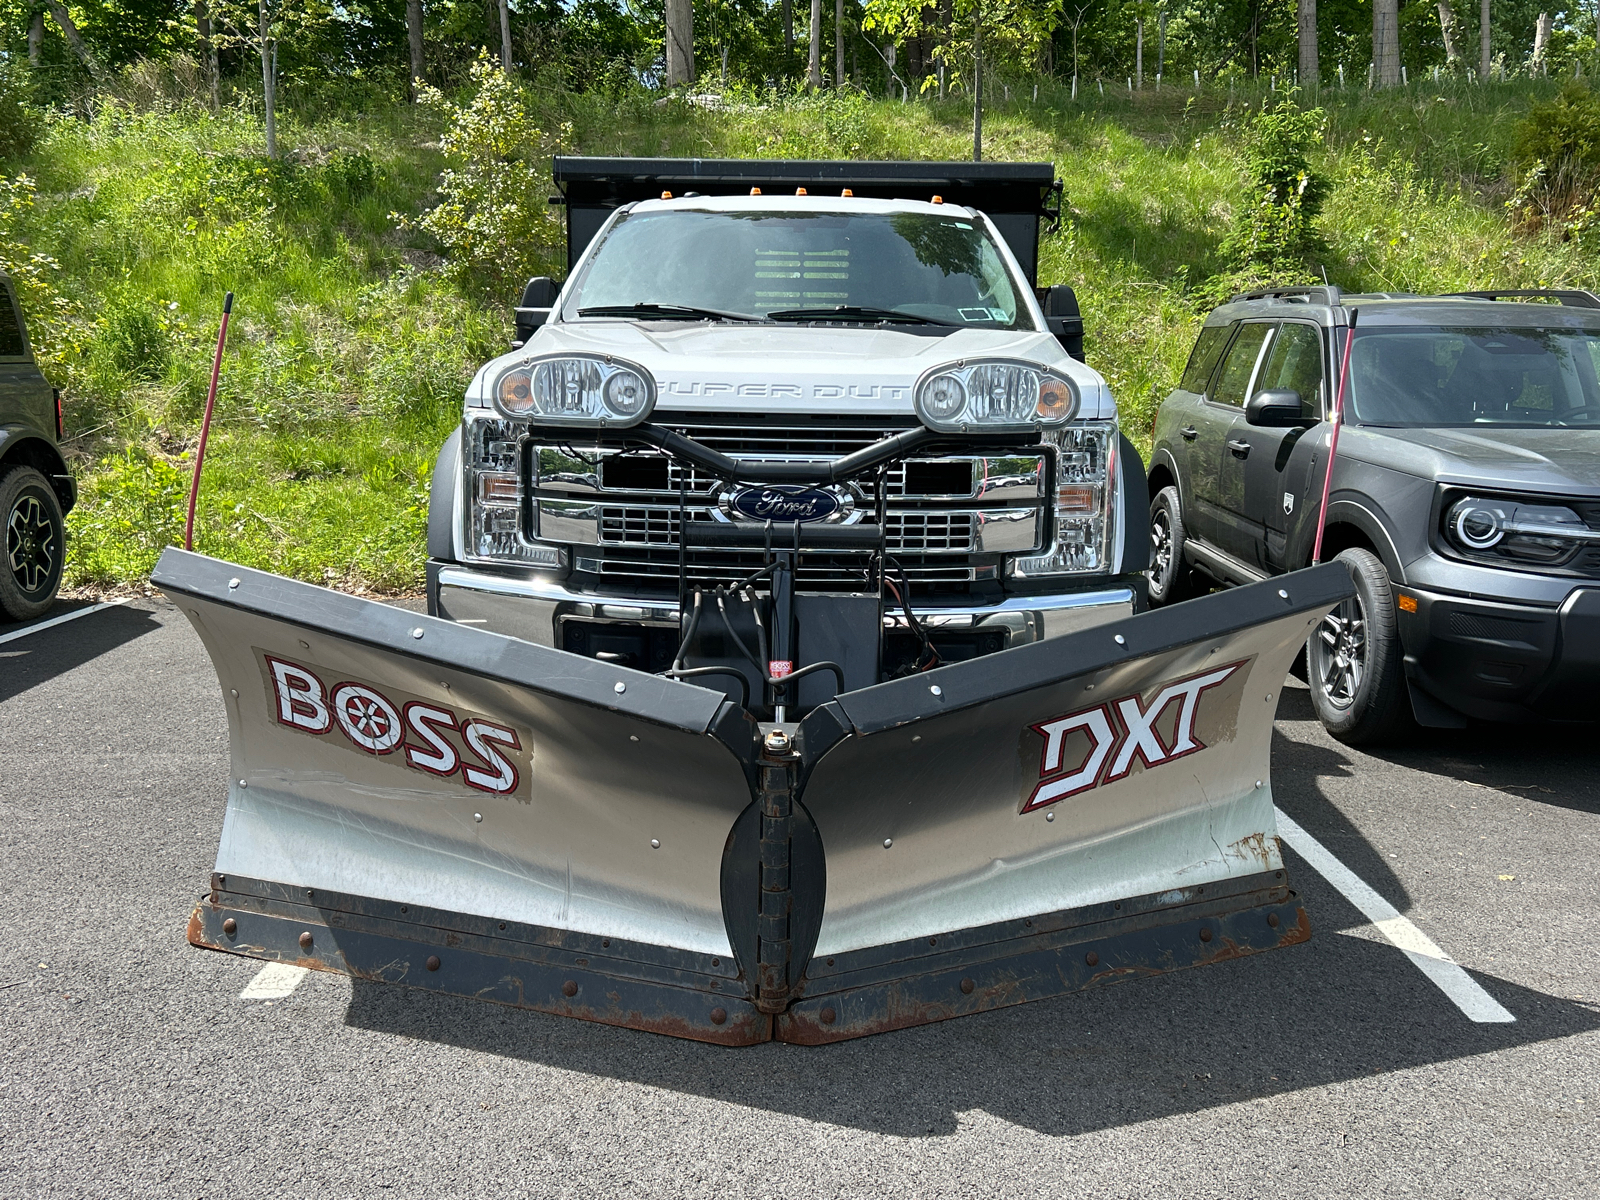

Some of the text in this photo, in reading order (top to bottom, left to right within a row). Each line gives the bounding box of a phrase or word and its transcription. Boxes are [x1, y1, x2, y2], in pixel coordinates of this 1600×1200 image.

[813, 384, 912, 399] DUT
[755, 490, 817, 515] Ford
[264, 654, 522, 795] BOSS
[1019, 658, 1251, 815] DXT
